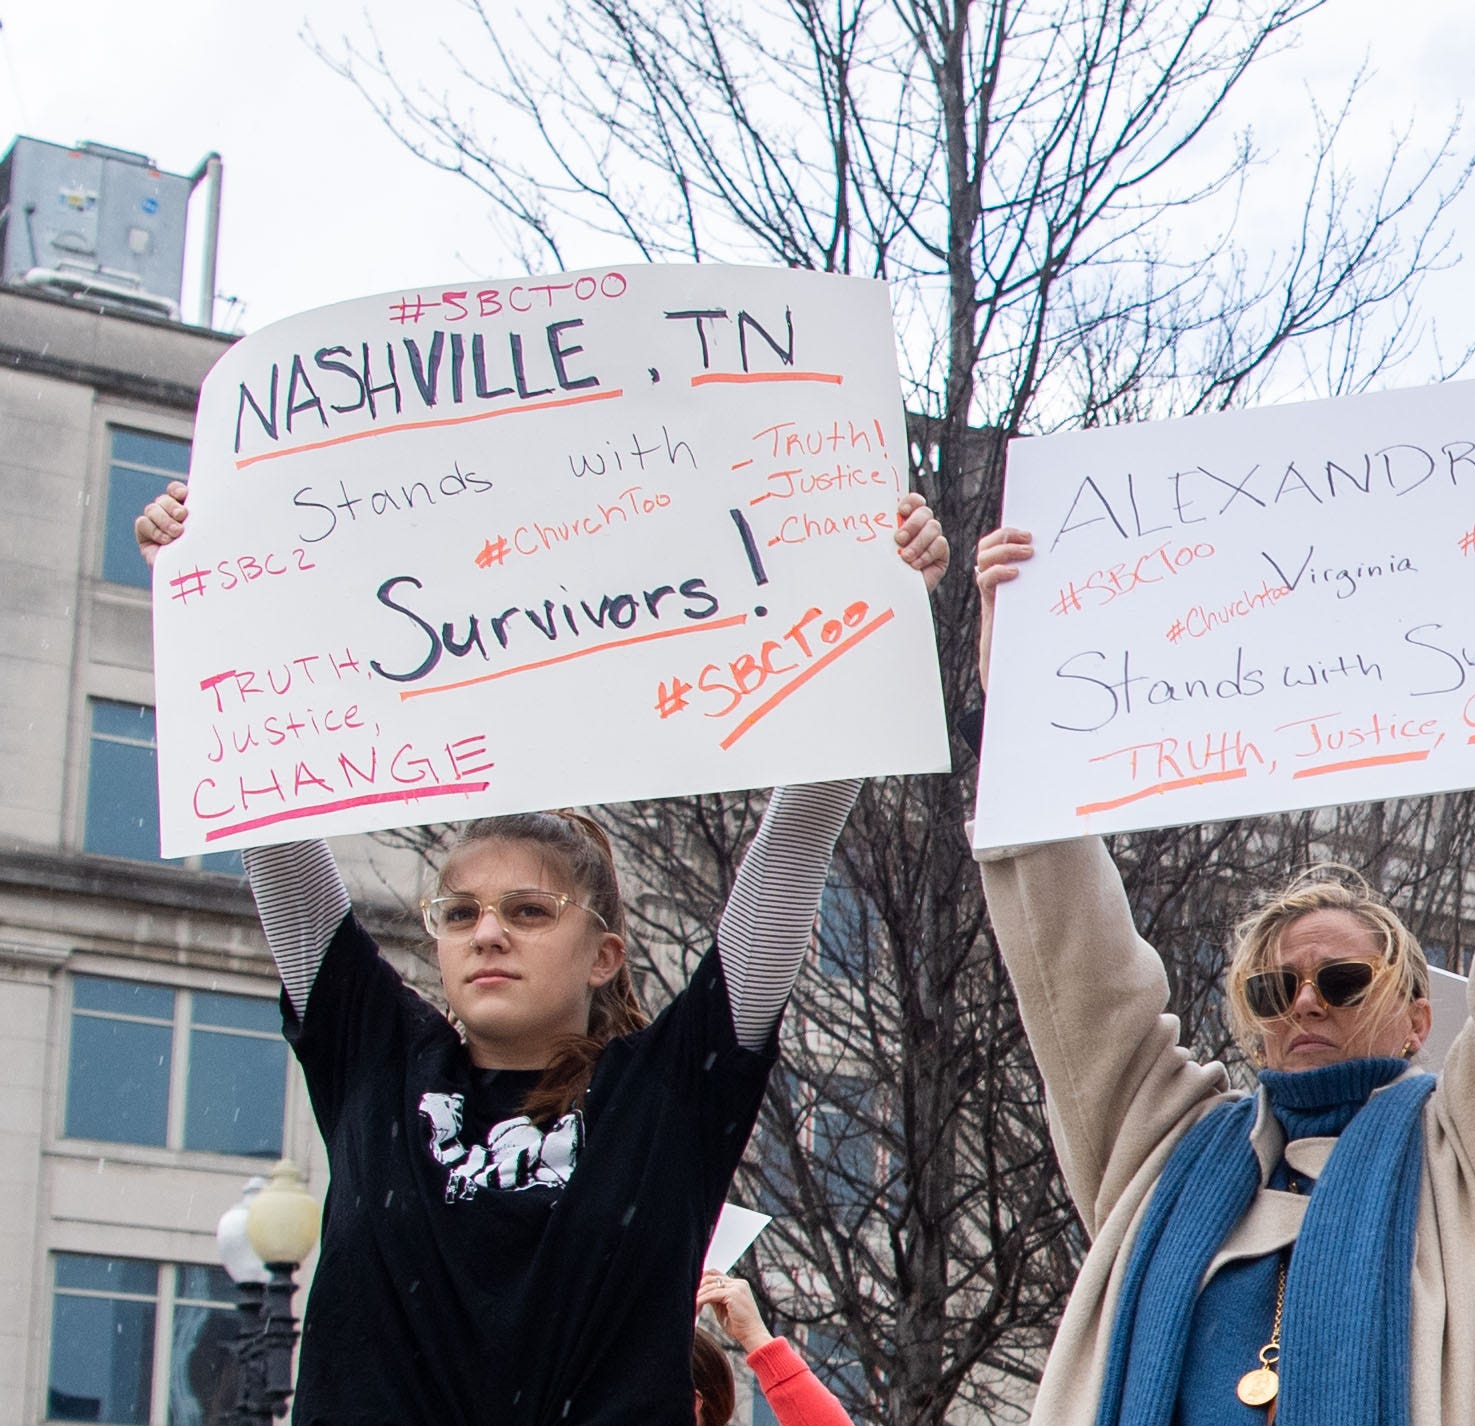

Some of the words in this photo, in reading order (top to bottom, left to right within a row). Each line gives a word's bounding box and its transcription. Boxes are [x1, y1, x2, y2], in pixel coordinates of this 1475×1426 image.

[663, 304, 794, 373] TN
[294, 461, 493, 542] Stands
[569, 425, 697, 477] with
[1262, 546, 1418, 599] Virginia
[1050, 647, 1264, 731] Stands
[1283, 654, 1382, 688] with
[194, 735, 494, 818] CHANGE
